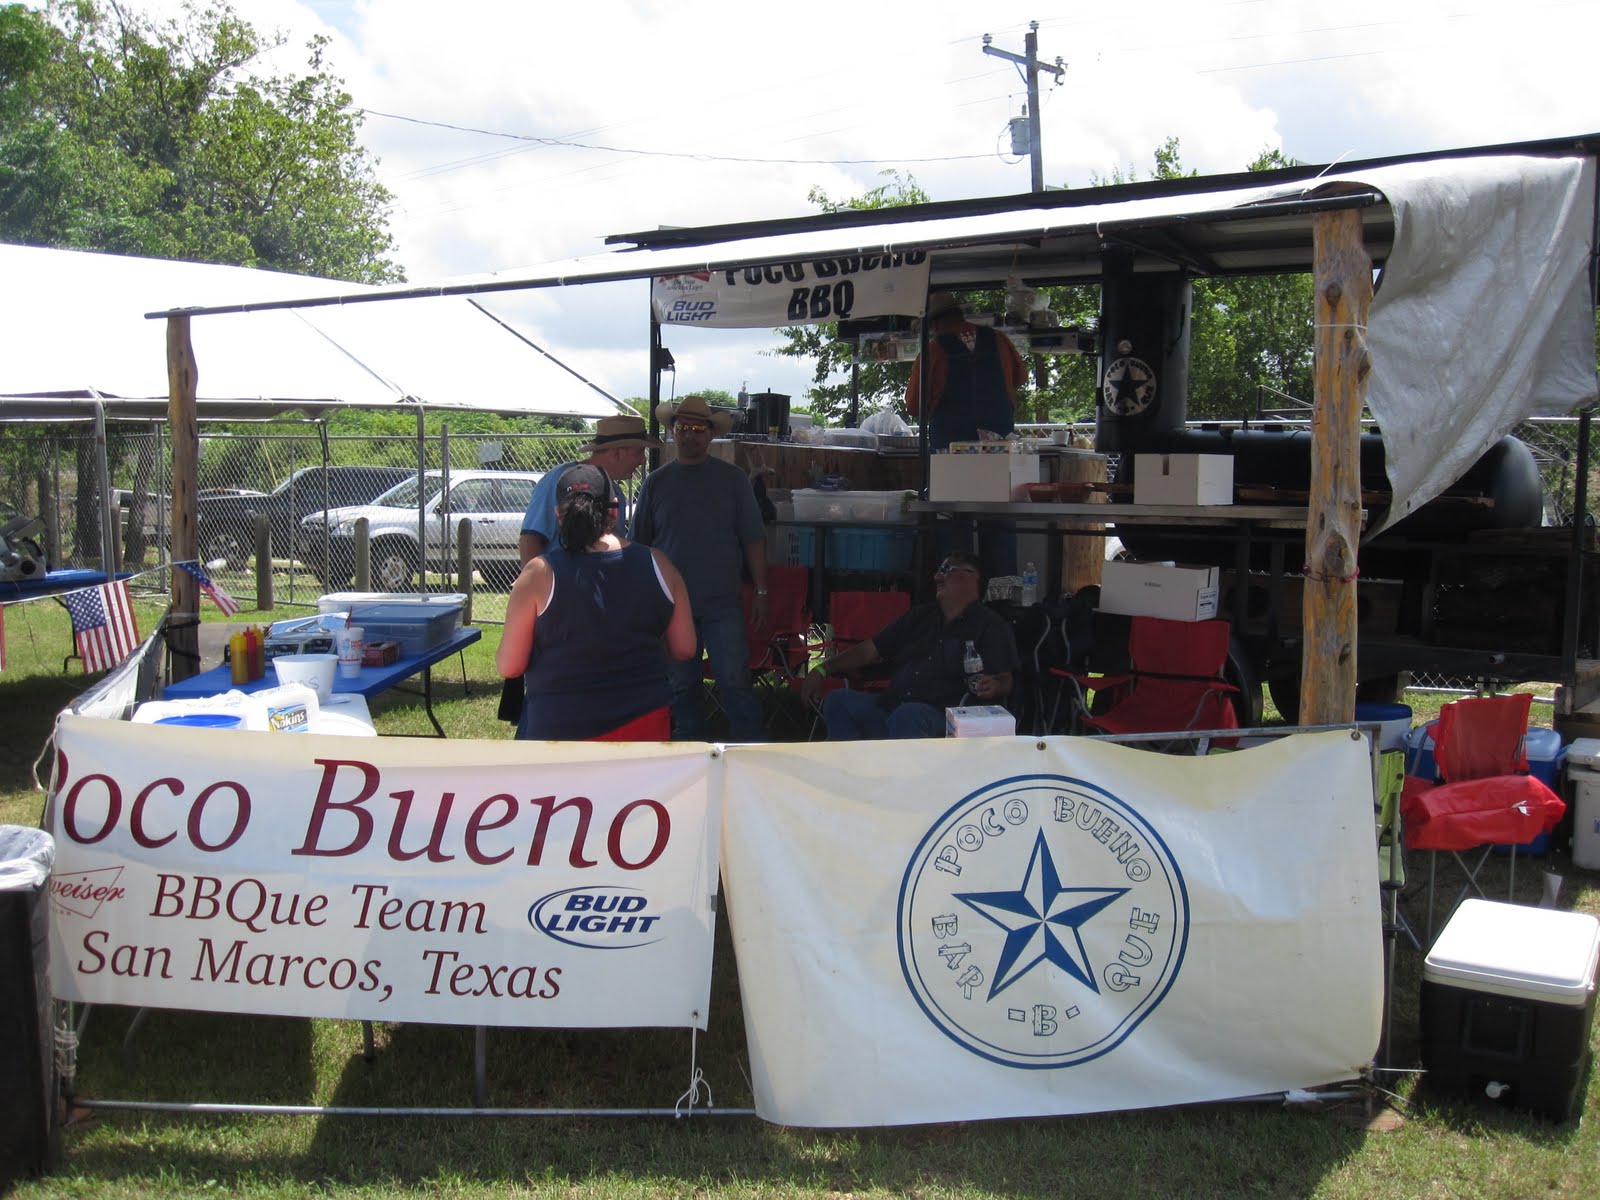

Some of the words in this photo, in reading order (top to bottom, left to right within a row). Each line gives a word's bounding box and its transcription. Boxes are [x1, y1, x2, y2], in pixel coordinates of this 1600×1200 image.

[667, 311, 718, 321] LIGHT
[673, 301, 715, 311] BUD
[788, 280, 855, 321] BBQ
[56, 747, 252, 852] oco
[291, 758, 671, 870] Bueno
[934, 798, 1029, 877] POCO
[1054, 796, 1152, 882] BUENO
[49, 877, 125, 901] weiser
[149, 873, 329, 933] BBQue
[351, 884, 488, 934] Team
[564, 894, 648, 913] BUD
[546, 914, 661, 933] LIGHT
[77, 930, 173, 979] San
[191, 938, 393, 1002] Marcos,
[422, 950, 563, 999] Texas
[931, 913, 984, 1000] BAR
[1103, 907, 1160, 992] QUE
